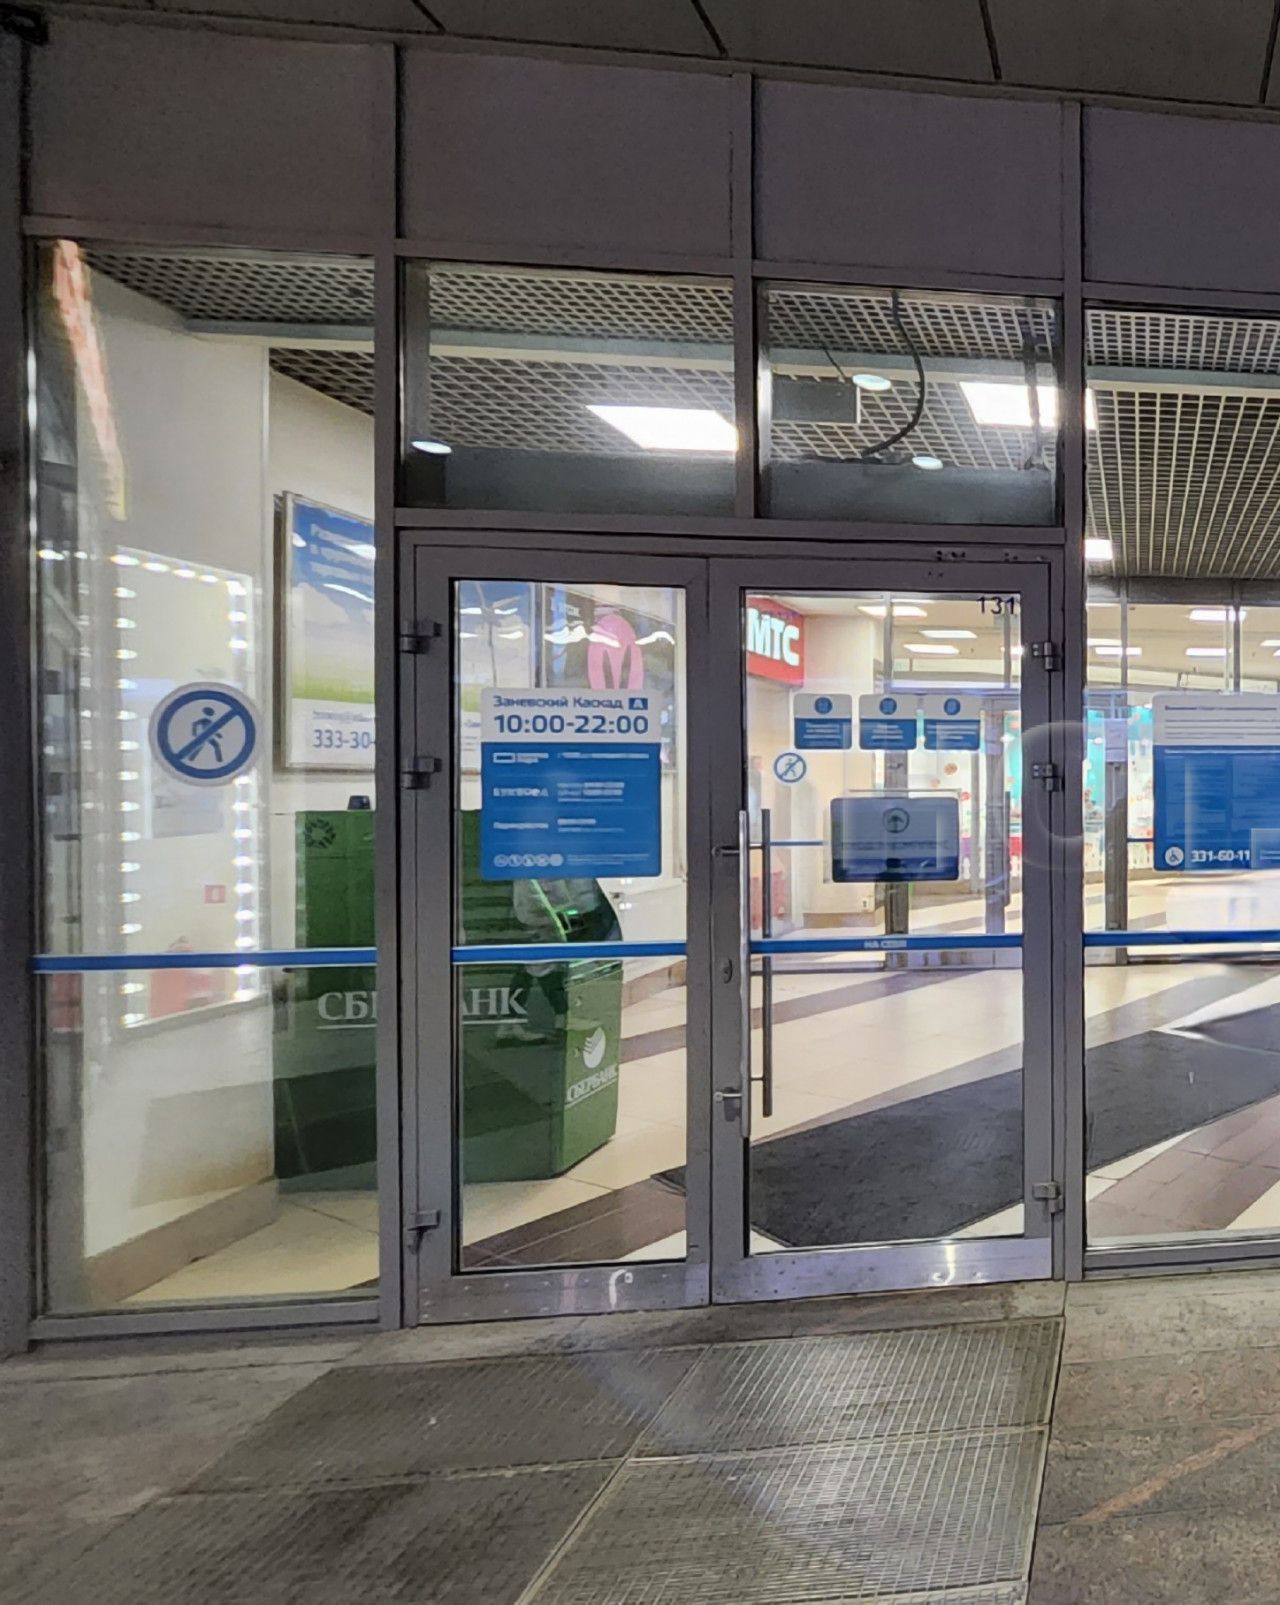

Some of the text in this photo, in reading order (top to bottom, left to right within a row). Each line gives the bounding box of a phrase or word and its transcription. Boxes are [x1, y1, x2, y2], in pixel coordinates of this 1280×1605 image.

[977, 596, 1018, 614] 131
[747, 607, 800, 667] МТС
[494, 713, 649, 734] 10:00-22:00
